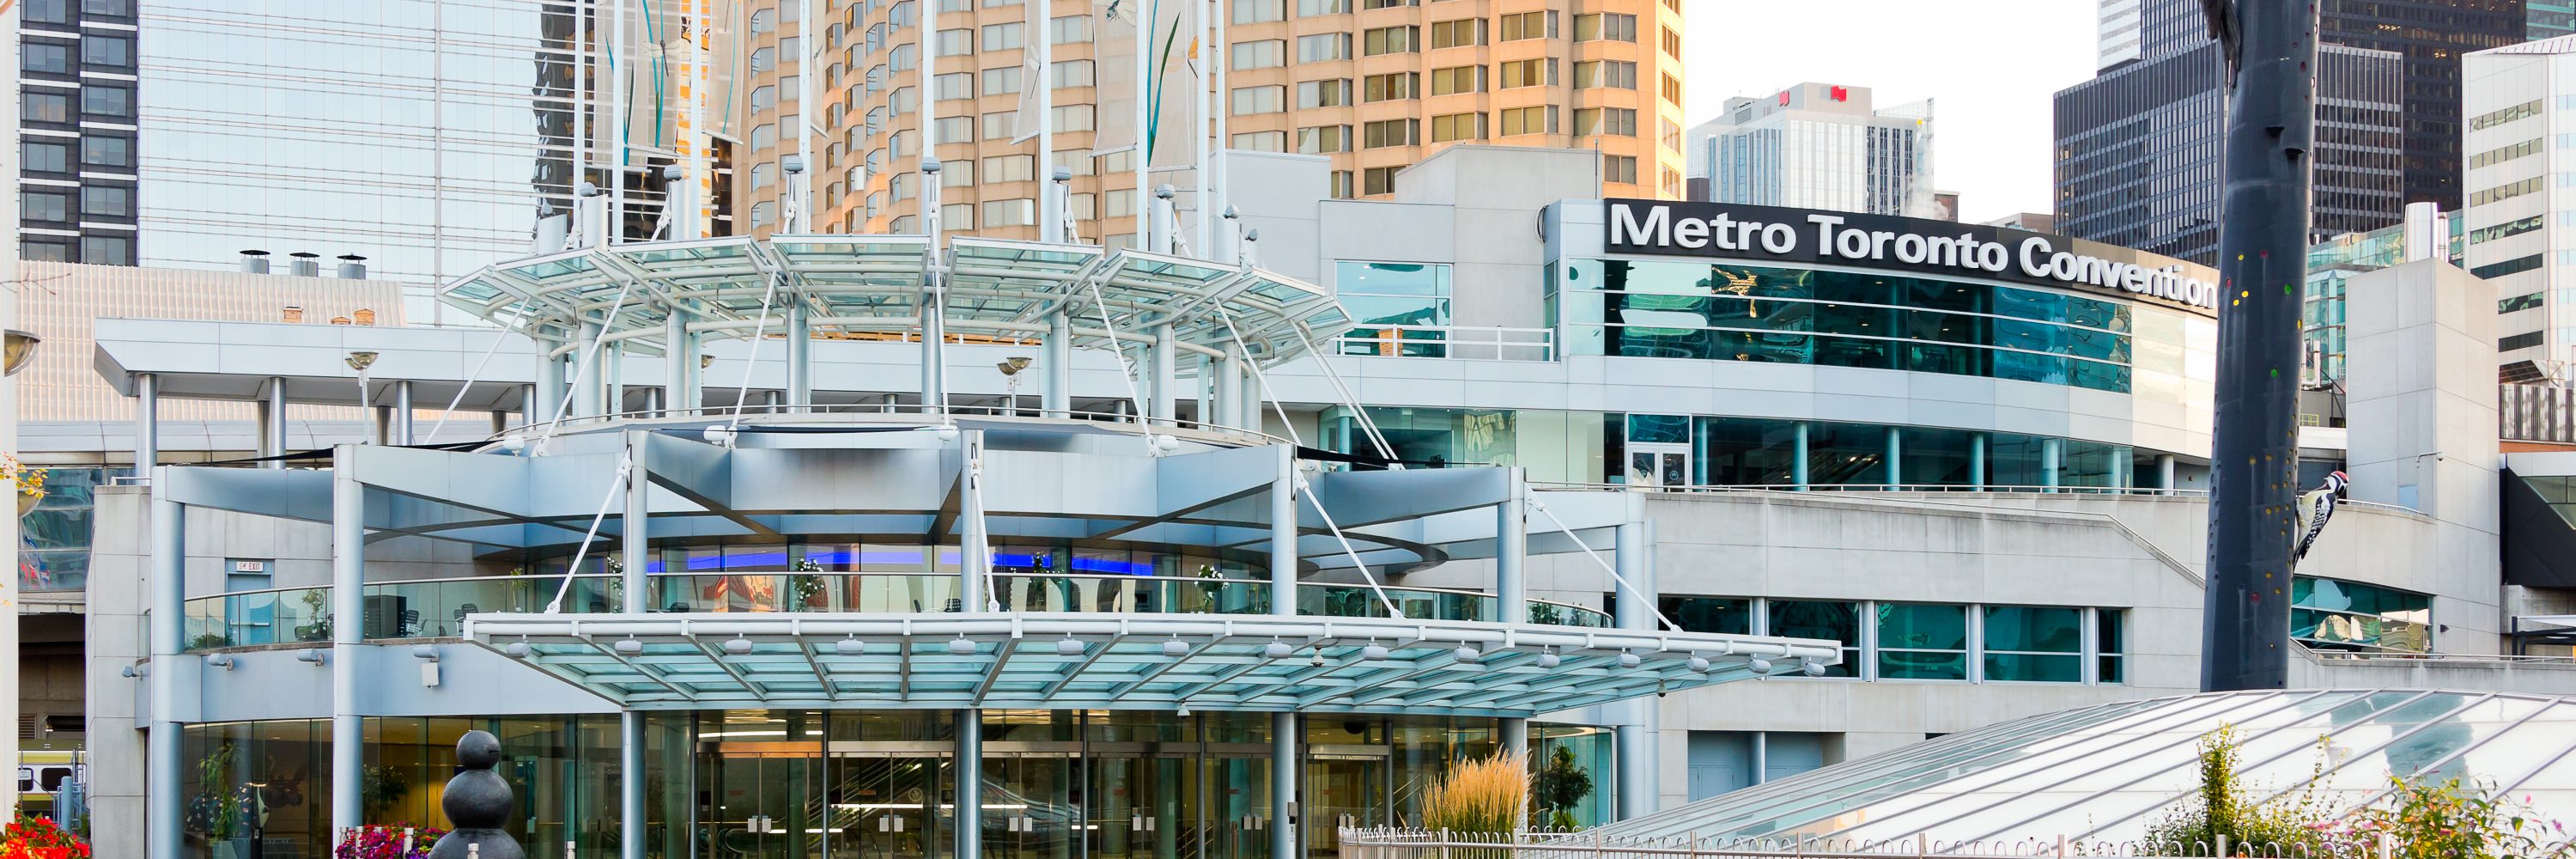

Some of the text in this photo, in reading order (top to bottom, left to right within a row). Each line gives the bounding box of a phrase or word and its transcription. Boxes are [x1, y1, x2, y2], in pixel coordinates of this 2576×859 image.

[1611, 204, 2216, 309] Metro Toronto Convention
